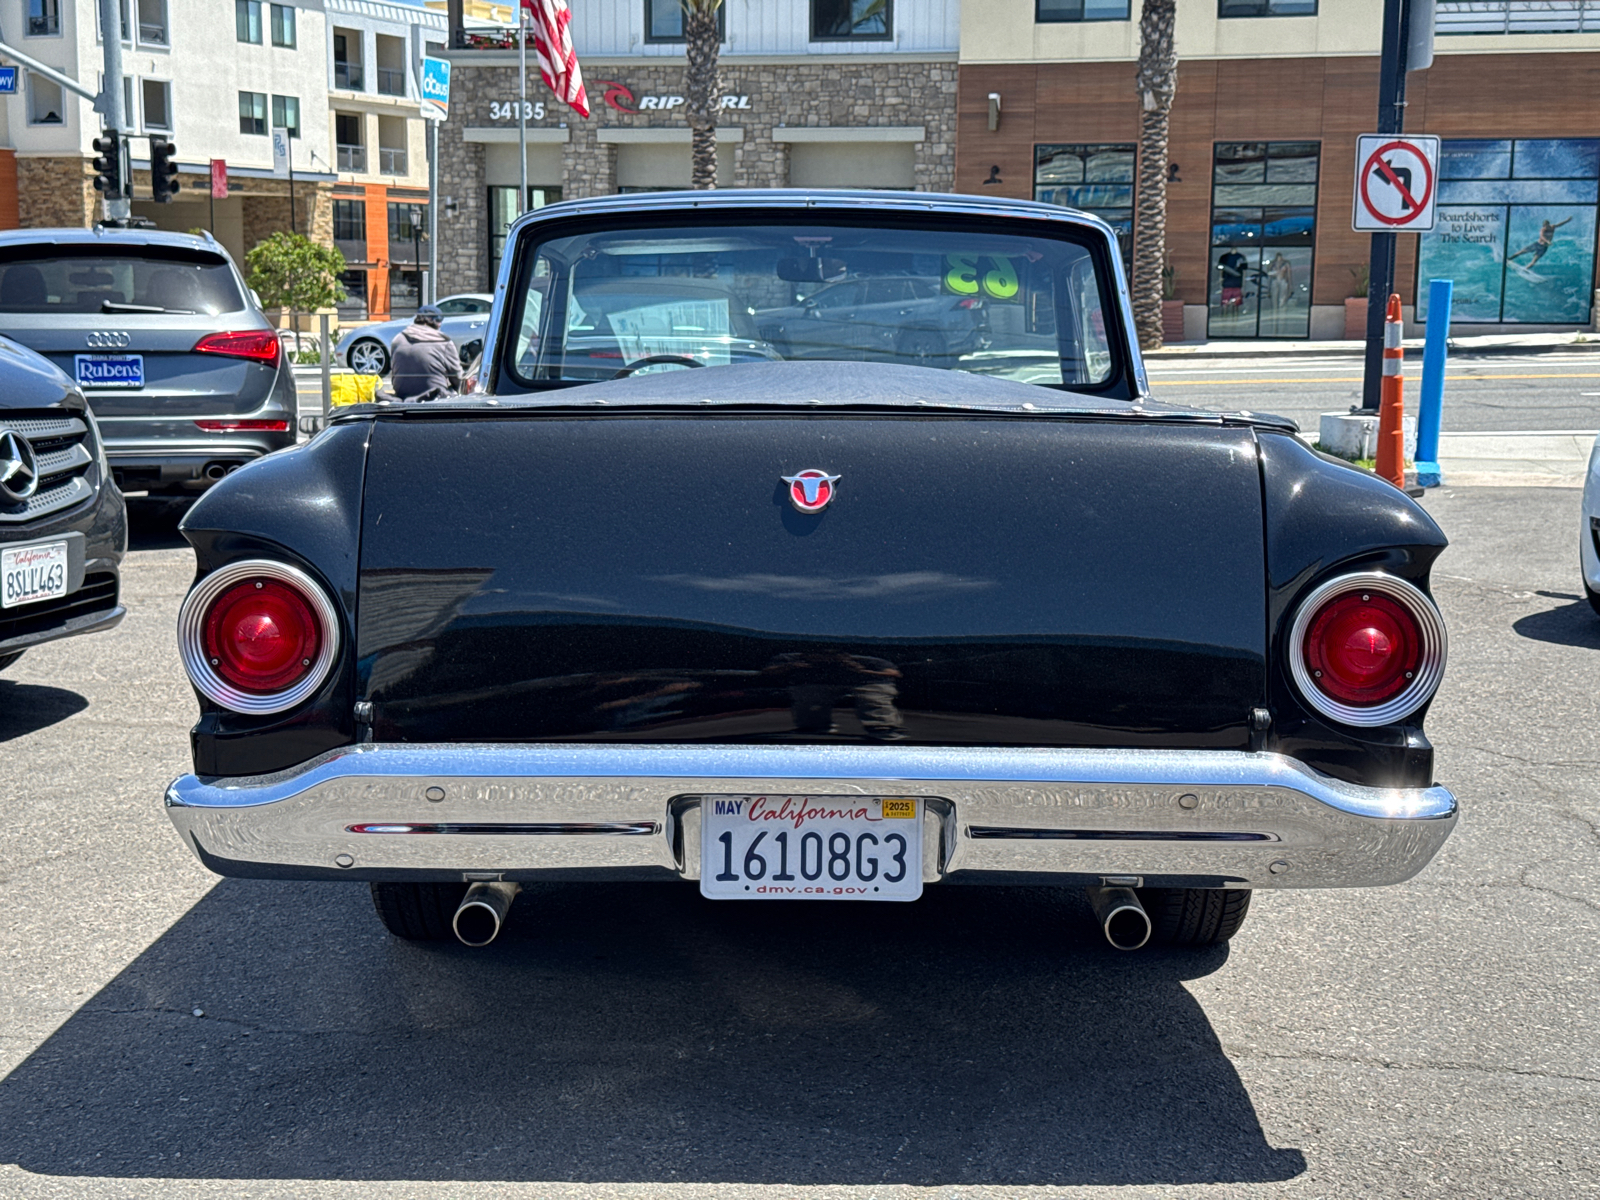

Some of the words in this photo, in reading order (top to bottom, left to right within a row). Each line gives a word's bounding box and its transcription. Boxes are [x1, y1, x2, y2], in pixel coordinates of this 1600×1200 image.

[0, 76, 13, 89] wy
[639, 96, 685, 110] RIP
[704, 95, 752, 109] RL
[489, 101, 545, 120] 34135
[1438, 211, 1499, 222] Boardshorts
[1451, 223, 1461, 232] to
[1464, 223, 1485, 232] Live
[1440, 233, 1460, 243] The
[1462, 233, 1497, 243] Search
[80, 362, 141, 379] Rubens
[715, 800, 743, 816] MAY
[748, 797, 883, 829] California
[889, 802, 910, 811] 2025
[715, 830, 907, 883] 16108G3
[756, 885, 868, 895] dmv.ca.gov
